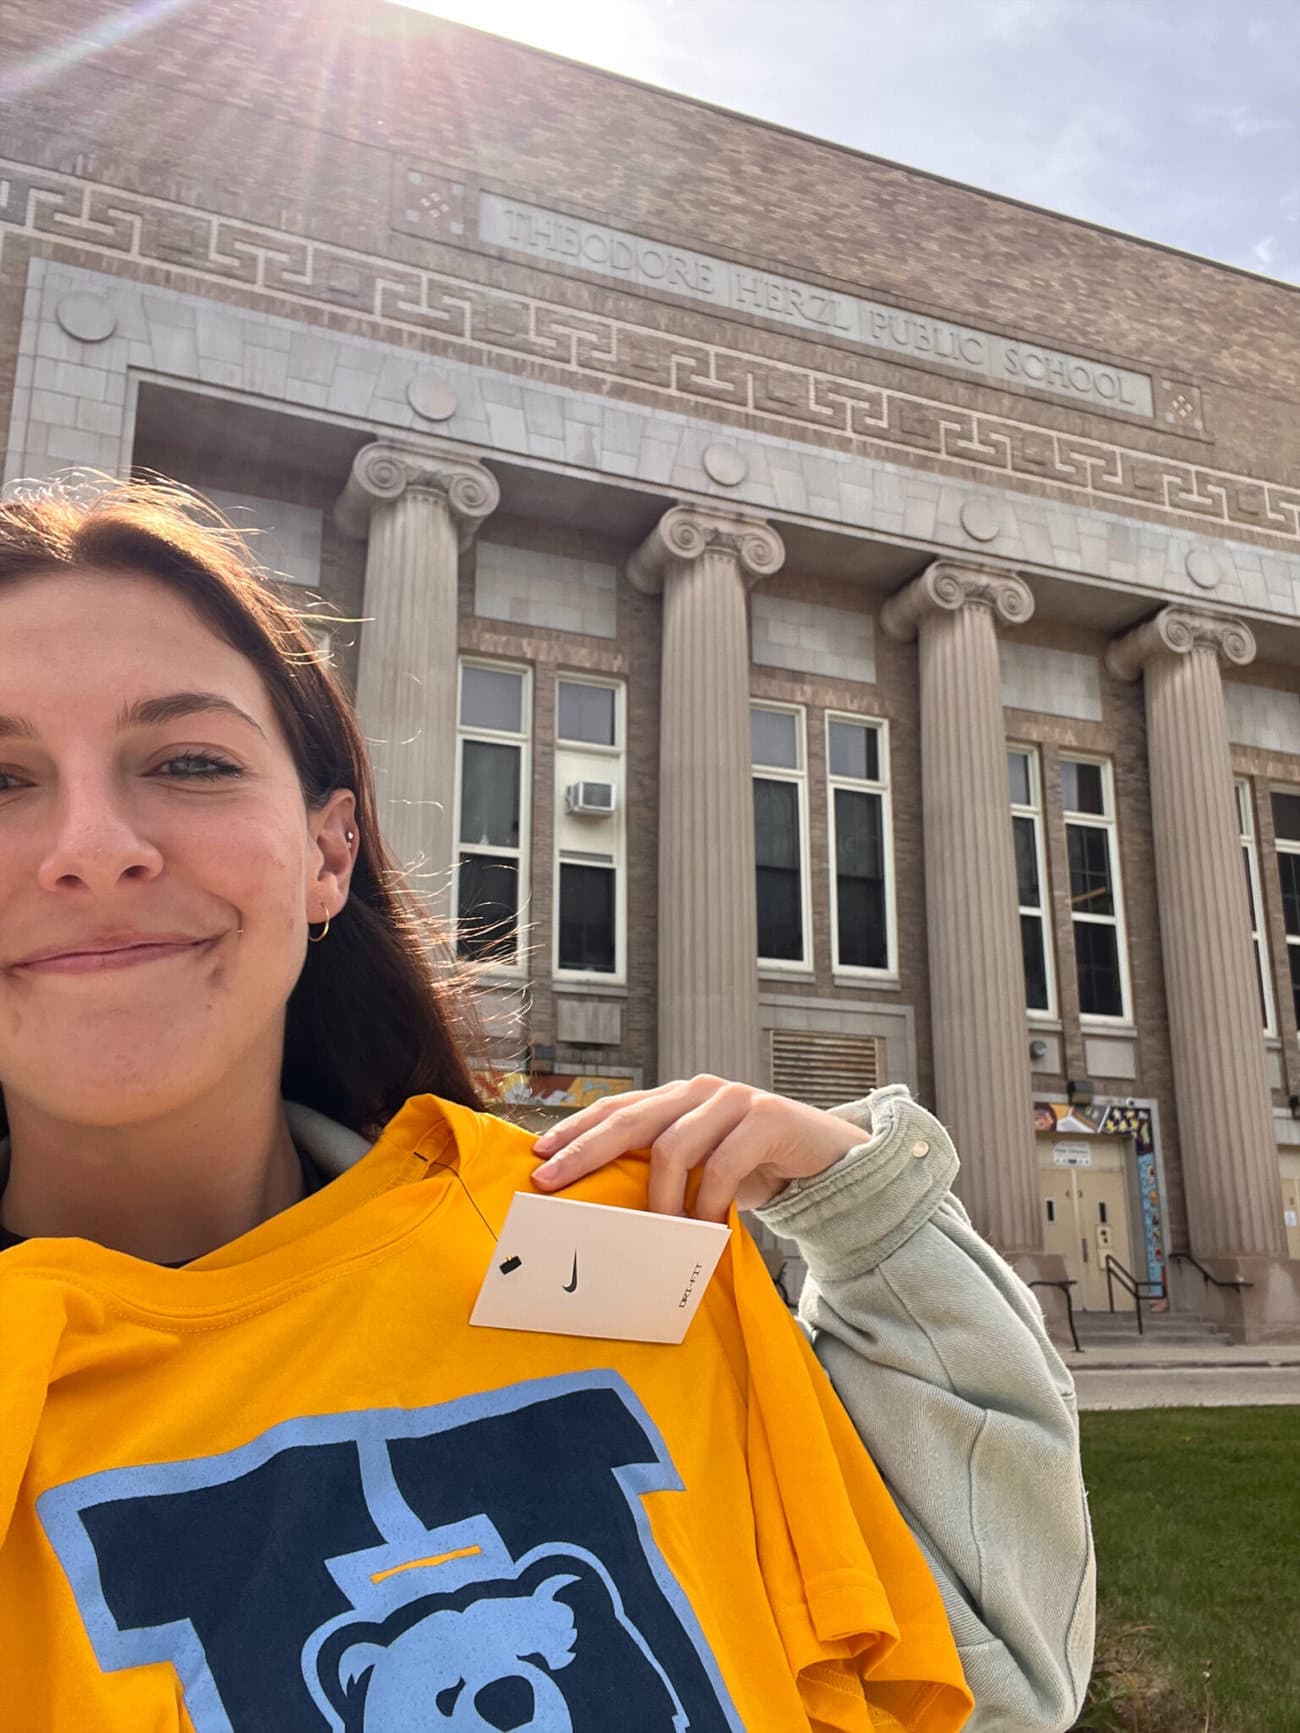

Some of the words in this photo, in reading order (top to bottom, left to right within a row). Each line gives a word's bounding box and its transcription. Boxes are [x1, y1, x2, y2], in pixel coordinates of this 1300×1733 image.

[503, 209, 713, 294] THEODORE
[735, 273, 849, 331] HERZL
[870, 309, 984, 366] PUBLIC
[1004, 348, 1134, 405] SCHOOL
[679, 1263, 702, 1308] DRI-FIT
